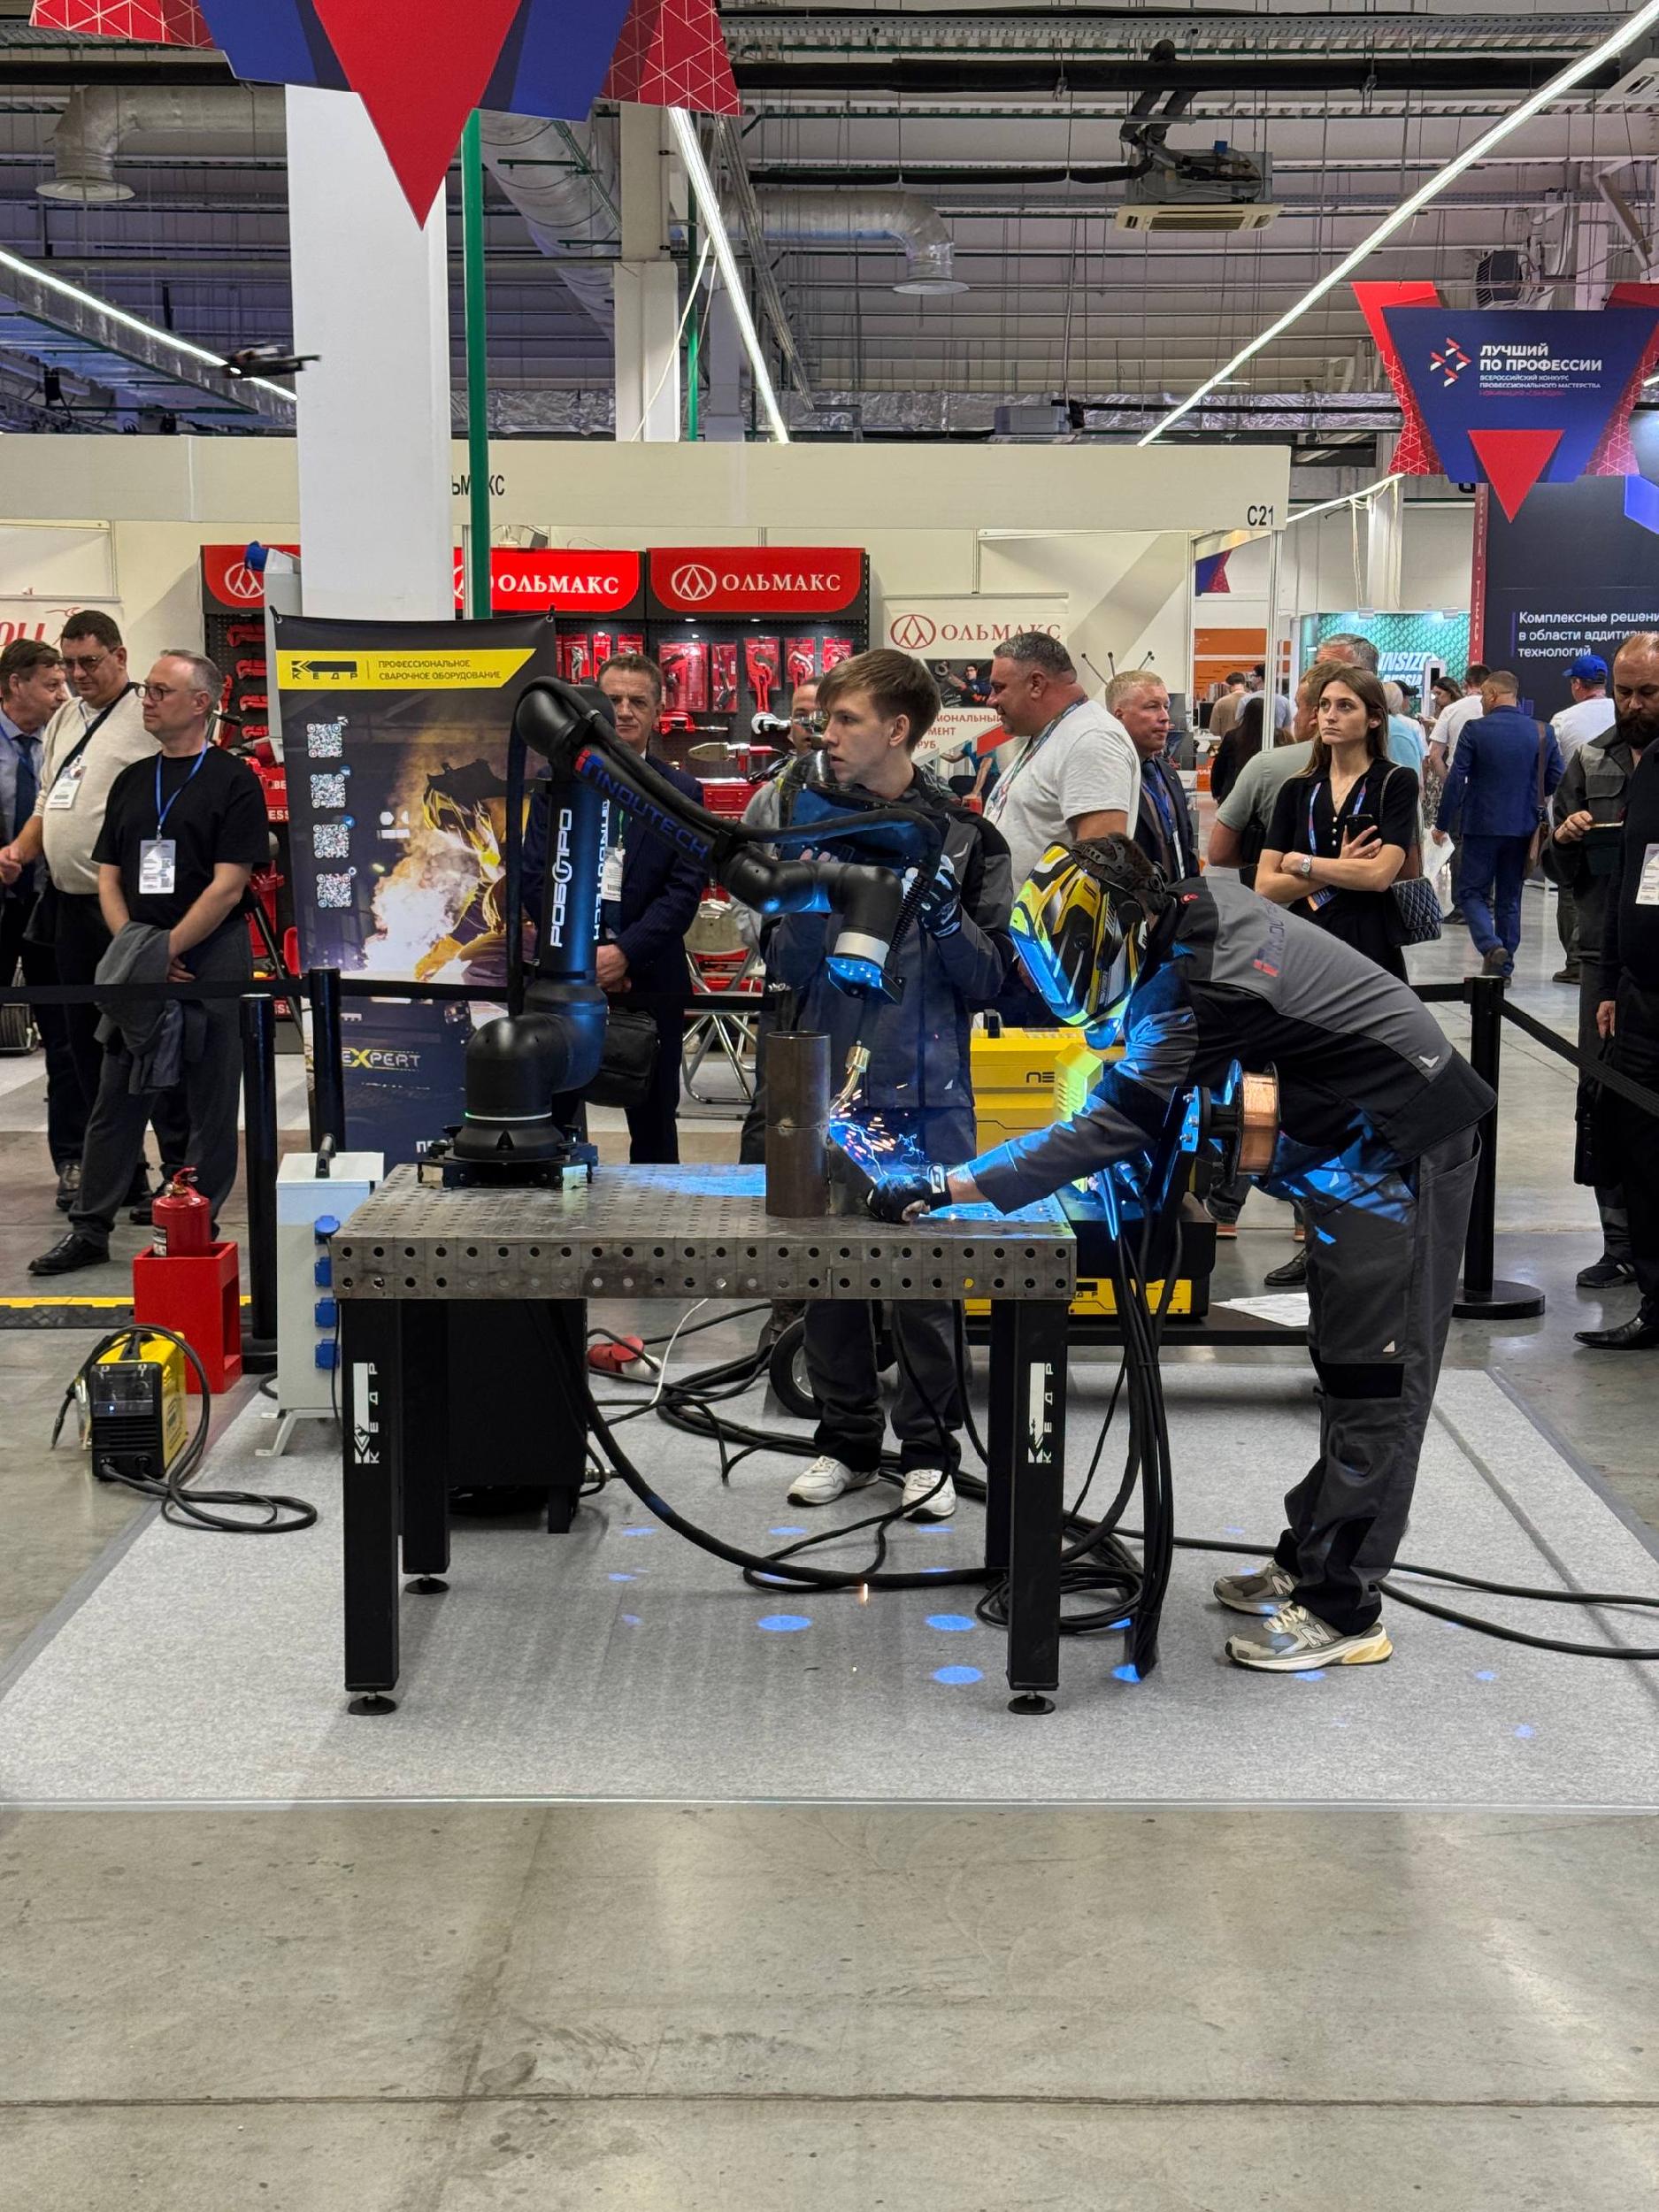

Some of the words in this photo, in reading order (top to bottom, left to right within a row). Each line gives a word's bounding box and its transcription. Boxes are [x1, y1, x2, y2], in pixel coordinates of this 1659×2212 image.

[1480, 343, 1548, 356] ЛУЧШИЙ
[1480, 359, 1502, 371] ПО
[1506, 359, 1602, 371] ПРОФЕССИИ
[498, 575, 618, 594] ОЛЬМАКС
[722, 574, 841, 591] ОЛЬМАКС
[1519, 612, 1607, 623] Комплексные
[1519, 631, 1526, 641] в
[1529, 629, 1580, 641] области
[1518, 646, 1592, 657] технологий
[378, 659, 471, 668] ПРОФЕССИОНАЛЬНОЕ
[433, 672, 502, 680] ОБОРУДОВАНИЕ
